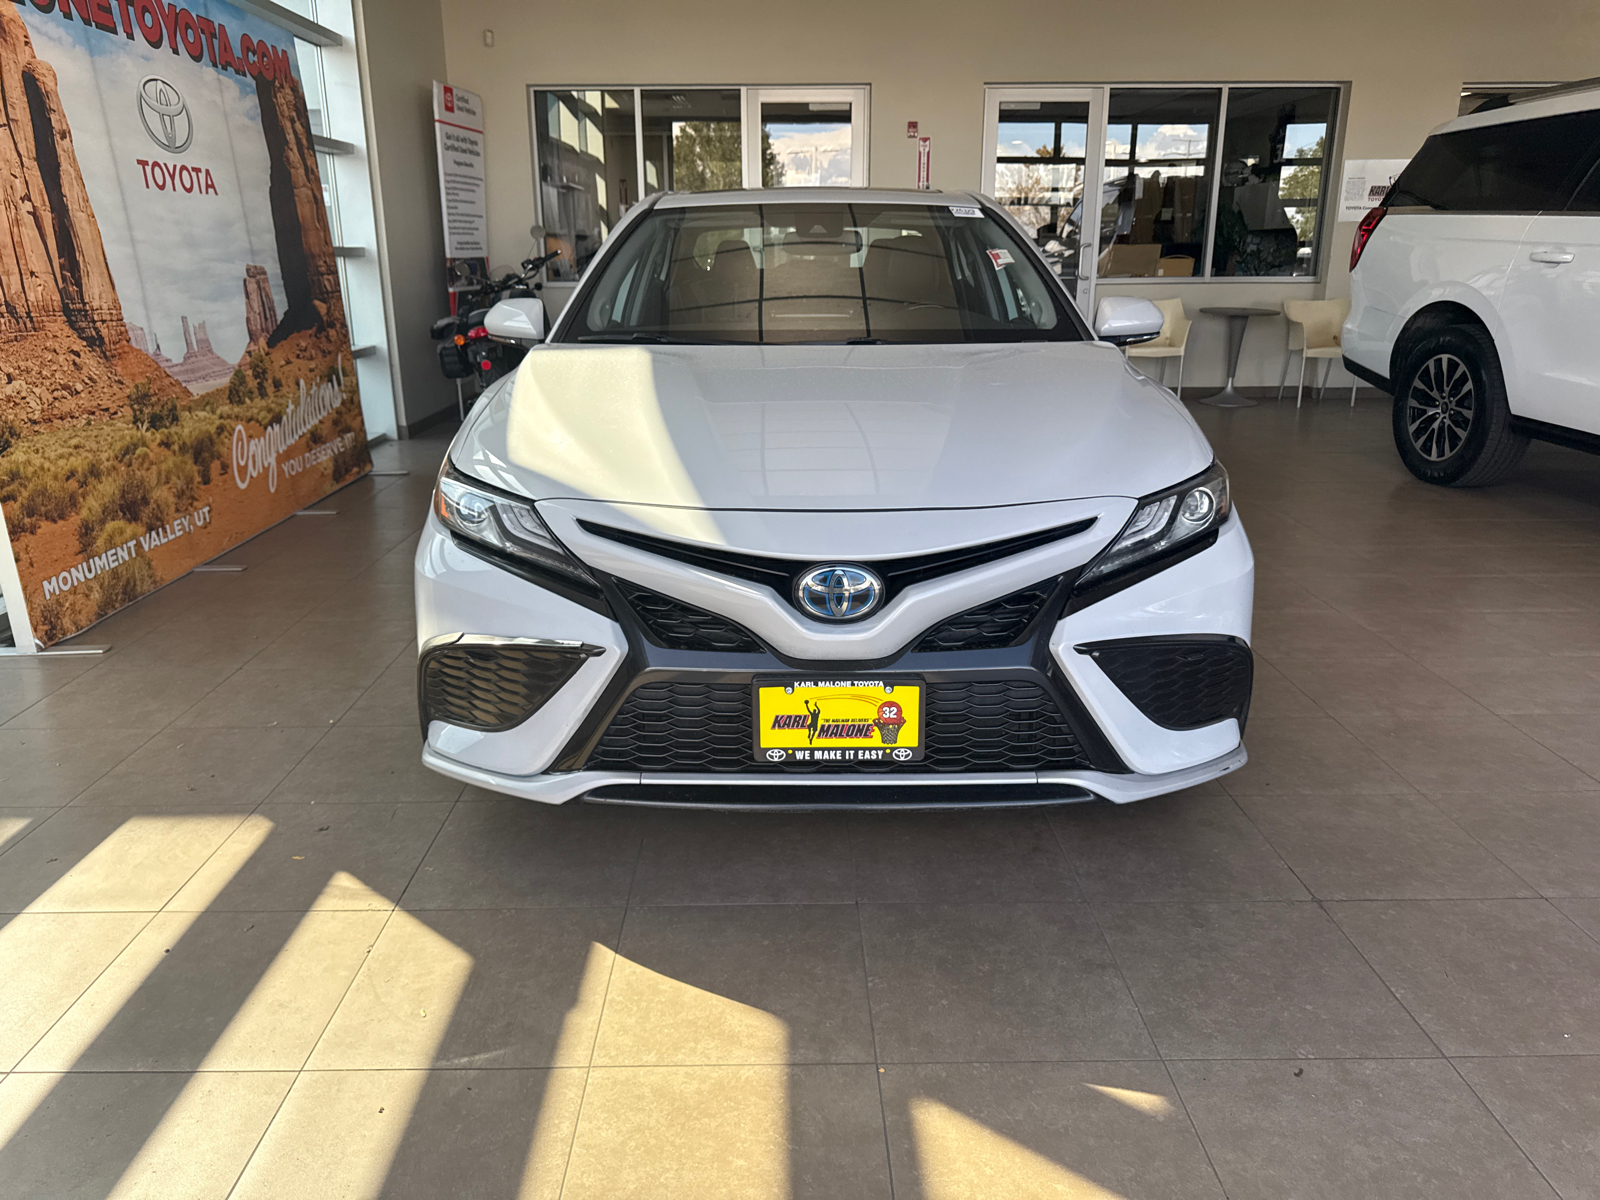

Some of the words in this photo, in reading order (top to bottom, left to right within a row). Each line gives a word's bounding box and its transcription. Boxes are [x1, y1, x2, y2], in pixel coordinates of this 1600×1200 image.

[136, 159, 218, 195] TOYOTA
[232, 352, 346, 493] Congratulations!
[281, 456, 303, 479] YOU
[304, 437, 345, 469] DESERVE
[42, 539, 137, 600] MONUMENT
[139, 515, 194, 552] VALLEY,
[193, 506, 210, 527] UT
[771, 714, 810, 730] KARL
[882, 707, 898, 719] 32
[816, 723, 875, 739] MALONE
[795, 751, 811, 760] WE
[814, 751, 842, 760] MAKE
[845, 751, 855, 760] IT
[858, 751, 883, 760] EASY
